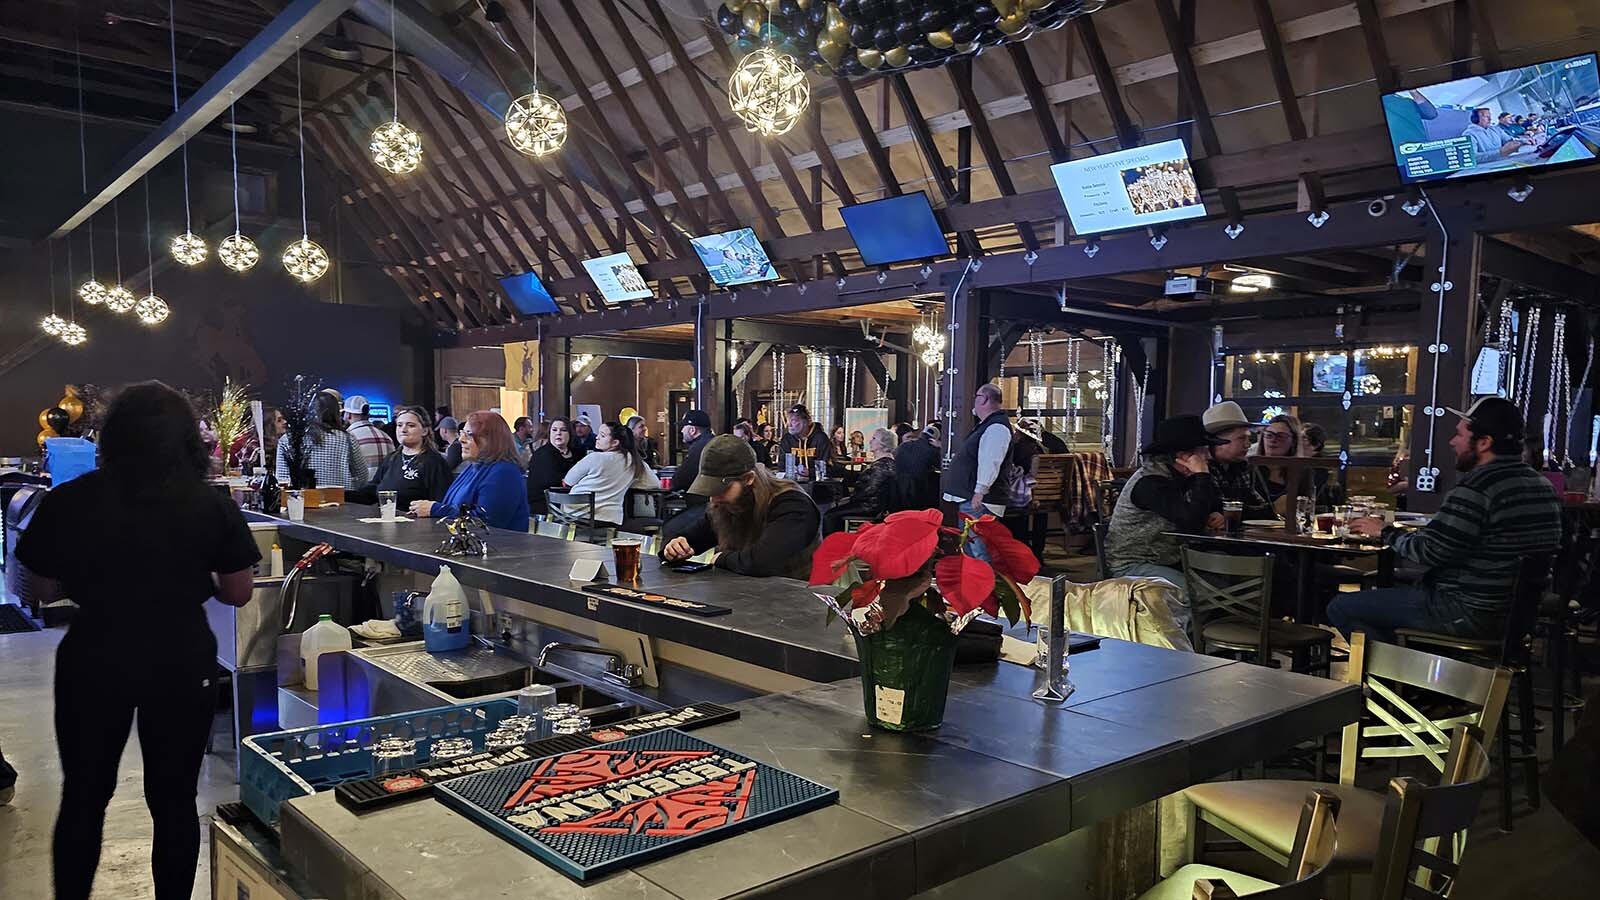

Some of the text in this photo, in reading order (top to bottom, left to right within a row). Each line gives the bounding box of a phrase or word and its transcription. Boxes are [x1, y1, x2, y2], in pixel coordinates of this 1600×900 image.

[671, 707, 704, 721] JIM
[615, 718, 683, 731] BEAM
[491, 746, 531, 765] JIM
[669, 754, 720, 771] SMALL
[420, 760, 498, 777] BEAM
[506, 757, 757, 828] TEREMANA
